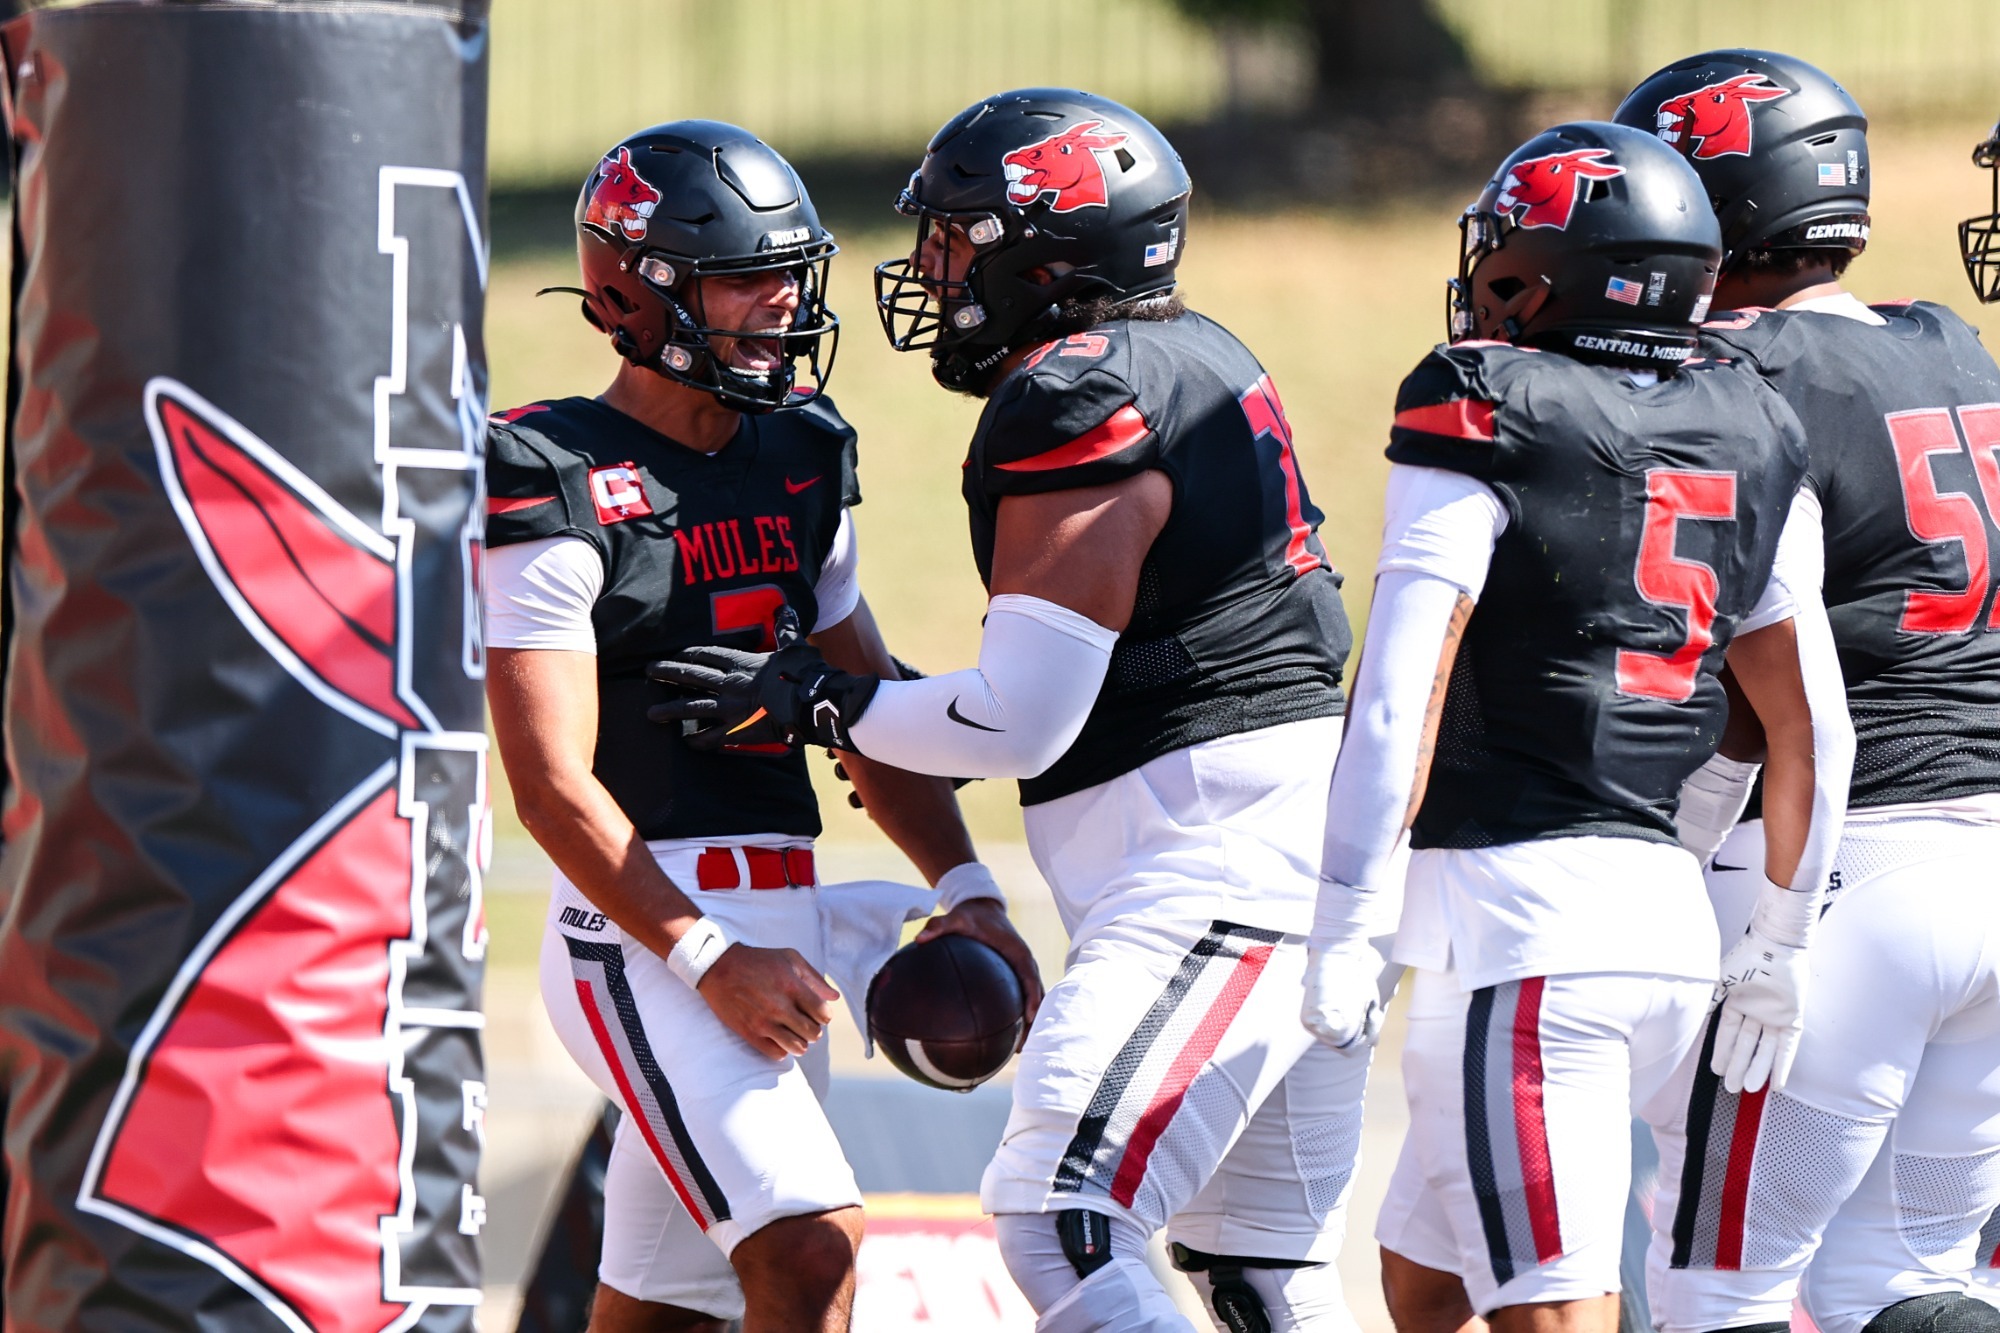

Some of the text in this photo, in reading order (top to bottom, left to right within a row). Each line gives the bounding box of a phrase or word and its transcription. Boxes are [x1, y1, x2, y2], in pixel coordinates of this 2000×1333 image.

[1805, 223, 1860, 239] CENTRAL
[1574, 335, 1648, 357] CENTRAL
[592, 467, 641, 508] C
[673, 516, 799, 585] MULES
[1615, 467, 1737, 704] 5
[559, 906, 609, 932] MULES
